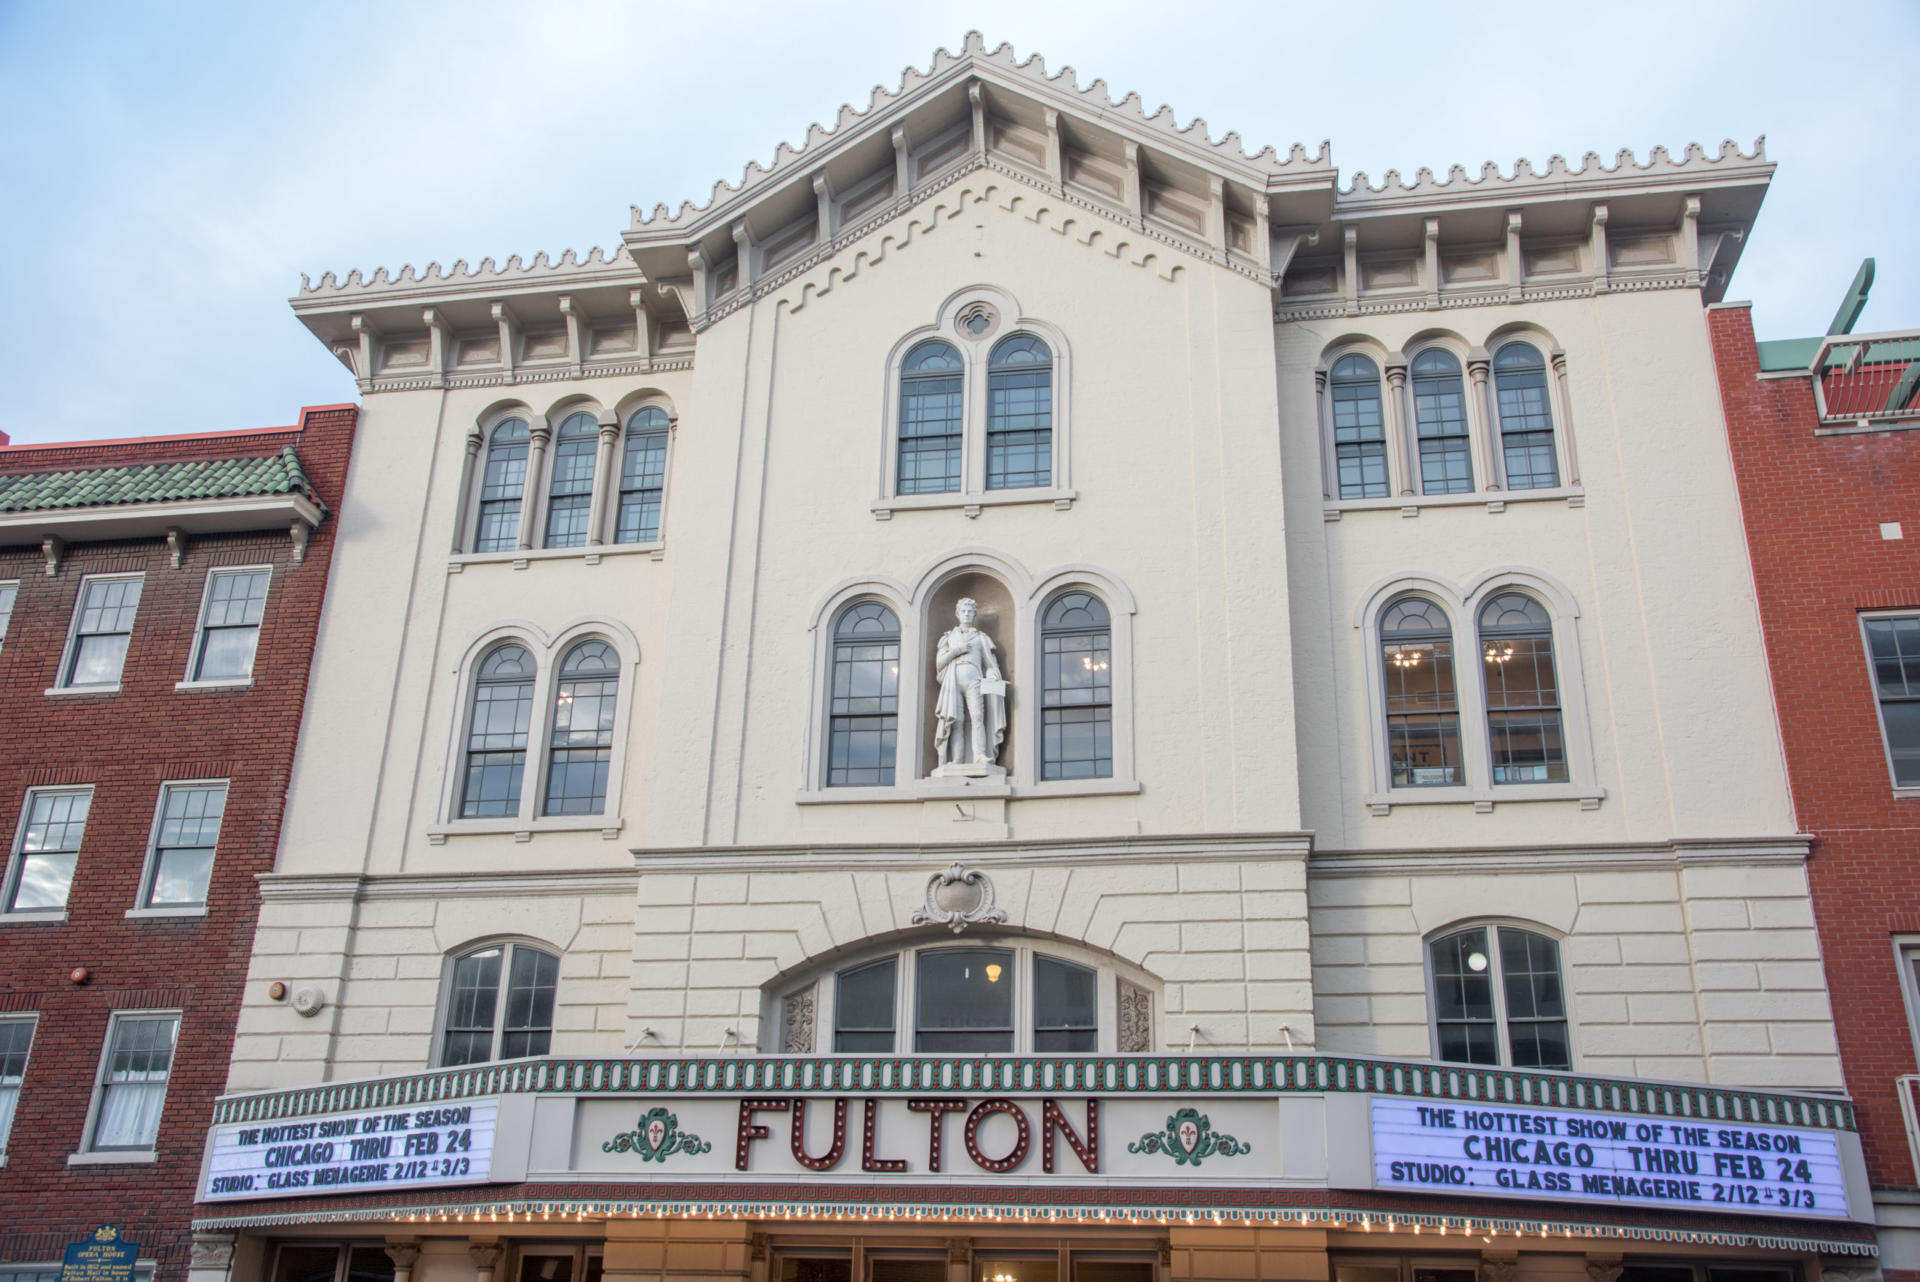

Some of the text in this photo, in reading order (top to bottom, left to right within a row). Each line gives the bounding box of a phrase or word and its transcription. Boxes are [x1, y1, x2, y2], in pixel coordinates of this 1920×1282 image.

[238, 1106, 472, 1146] THE HOTTEST SHOW OF THE SEASON
[736, 1099, 1100, 1173] FULTON
[1416, 1106, 1801, 1155] THE HOTTEST SHOW OF THE SEASON
[264, 1128, 472, 1168] CHICAGO THRU FEB 24
[1463, 1134, 1812, 1184] CHICAGO THRU FEB 24
[267, 1169, 310, 1189] GLASS
[313, 1163, 389, 1186] MENAGERIE
[1391, 1161, 1475, 1187] STUDIO:
[1495, 1168, 1571, 1193] GLASS
[1582, 1174, 1702, 1201] MENAGERIE
